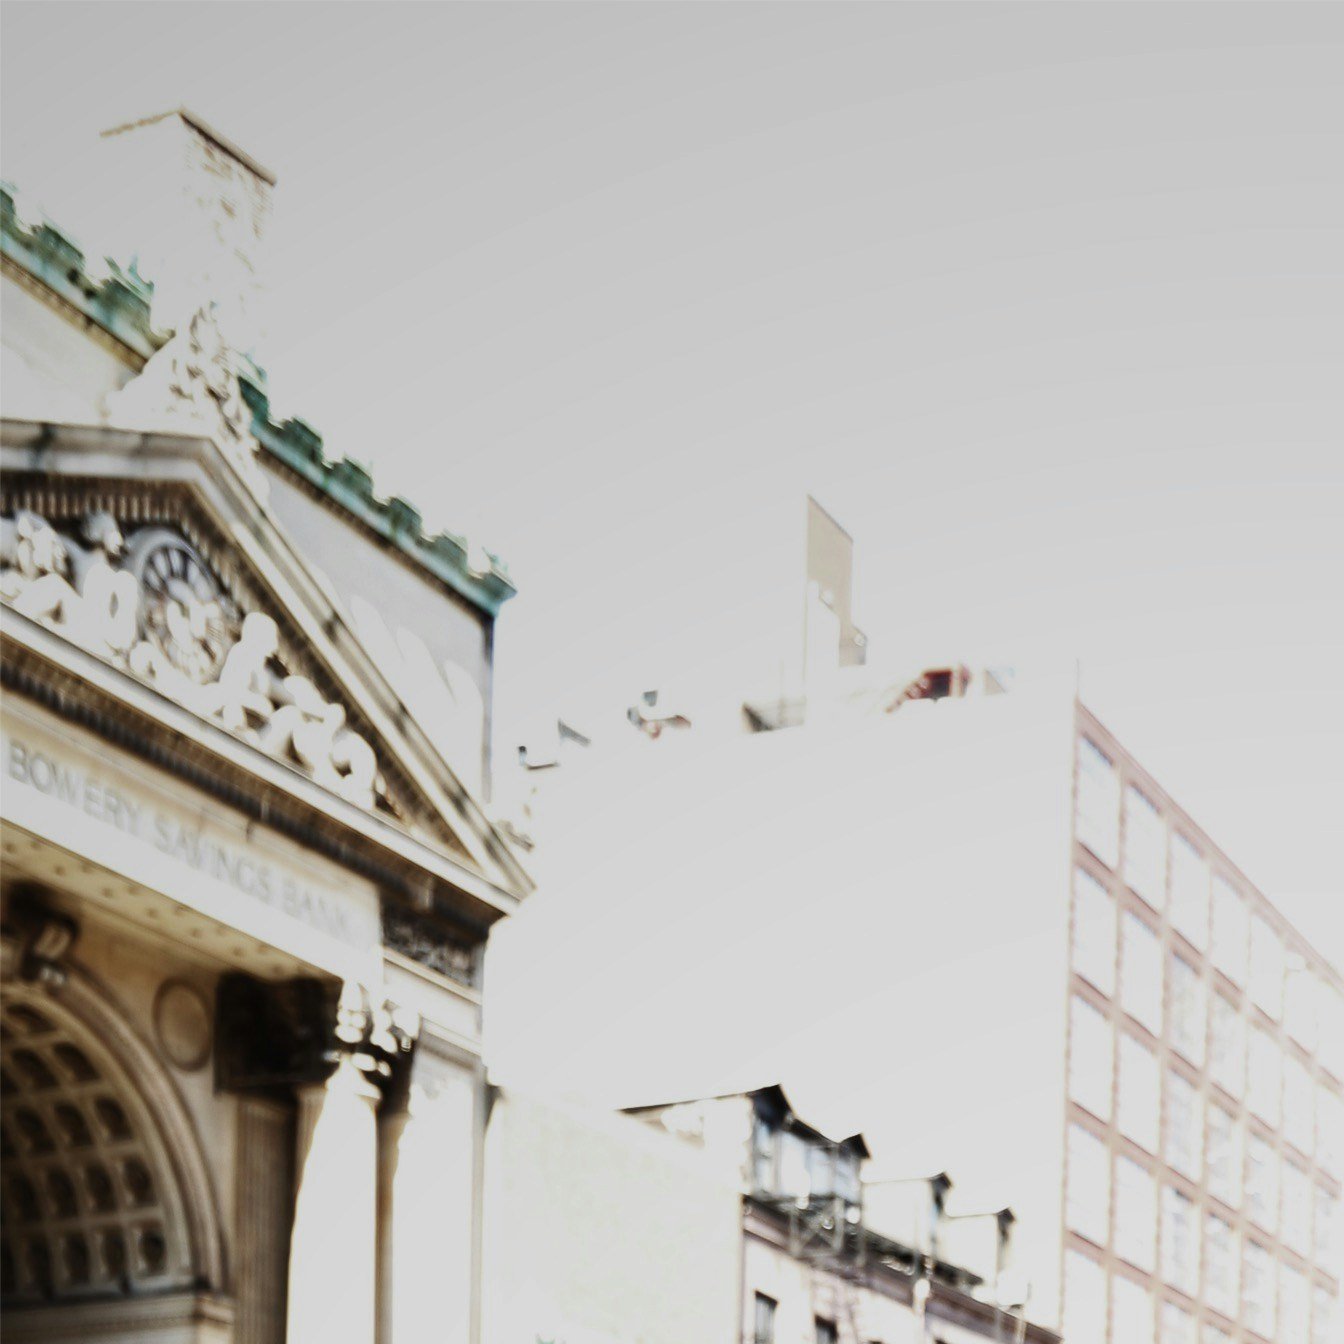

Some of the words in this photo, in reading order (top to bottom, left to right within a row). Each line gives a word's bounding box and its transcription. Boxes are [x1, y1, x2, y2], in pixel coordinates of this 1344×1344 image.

[9, 738, 140, 837] BOWERY
[155, 813, 272, 904] SAVINGS
[281, 876, 350, 943] BANK
